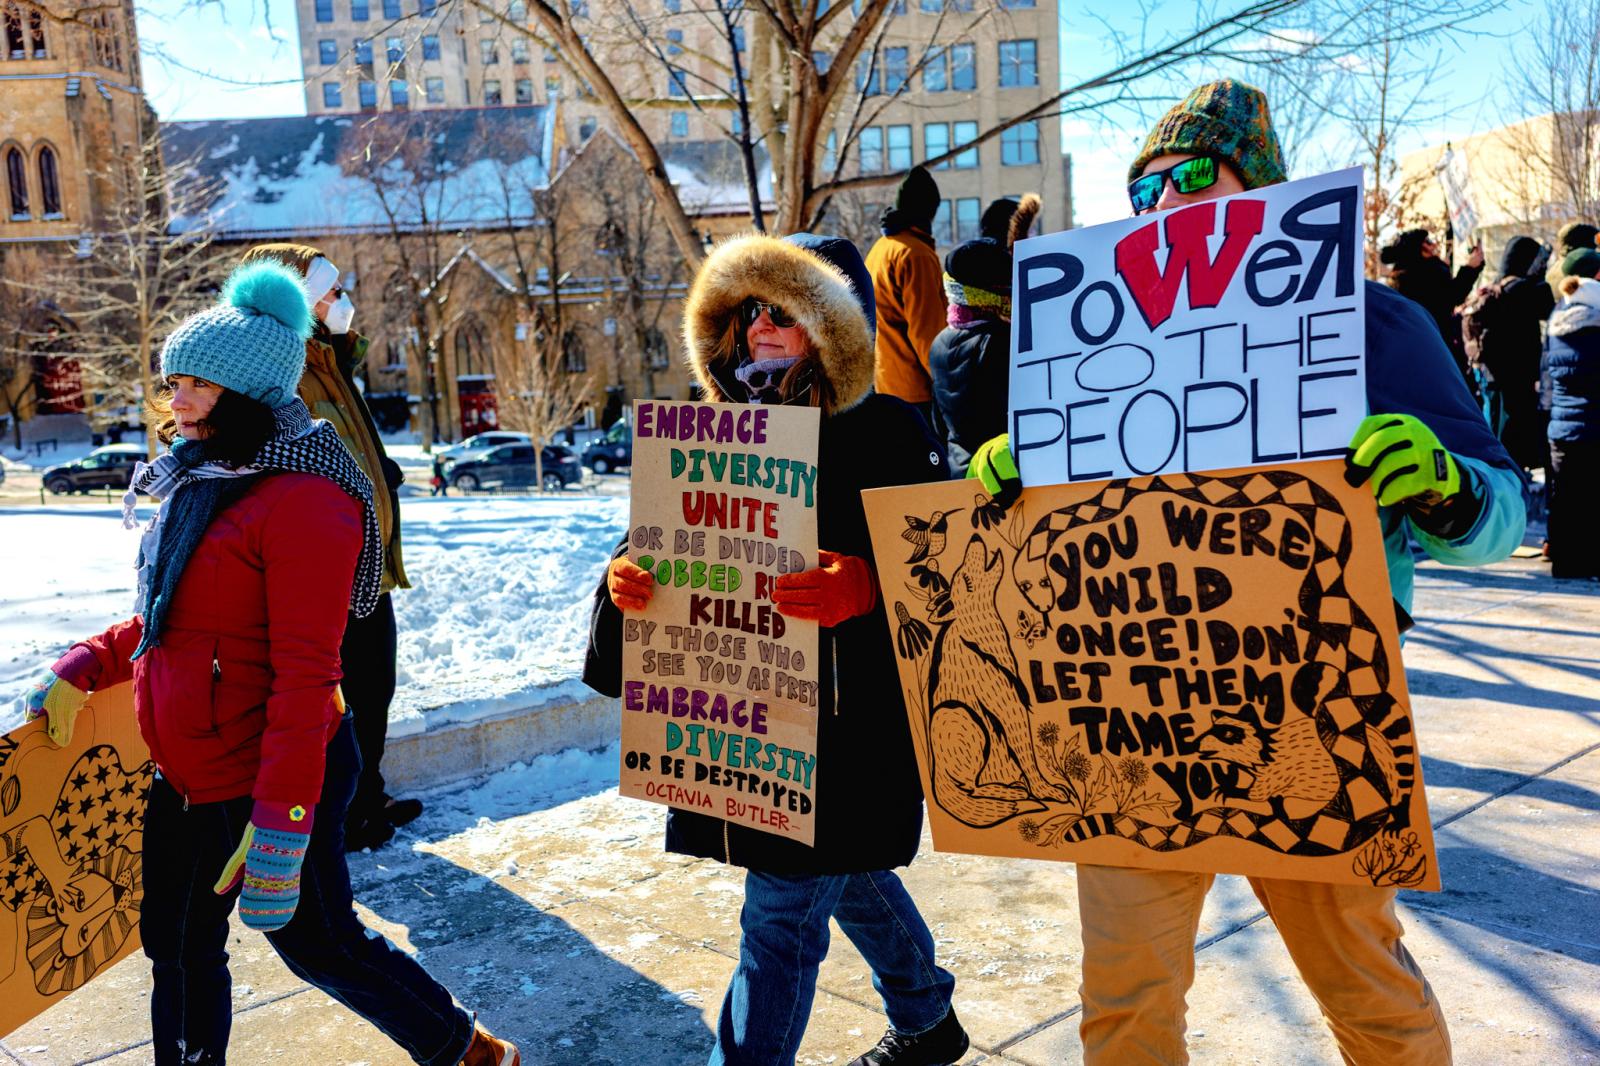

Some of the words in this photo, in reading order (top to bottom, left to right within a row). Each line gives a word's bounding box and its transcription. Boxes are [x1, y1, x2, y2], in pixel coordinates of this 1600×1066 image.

[1017, 343, 1155, 400] TO
[1164, 307, 1361, 379] THE
[637, 403, 768, 444] EMBRACE
[1013, 369, 1357, 482] PEOPLE
[671, 448, 817, 508] DIVERSITY
[682, 490, 779, 539] UNITE
[632, 526, 664, 550] OR
[674, 529, 706, 557] BE
[719, 535, 806, 573] DIVIDED
[1049, 514, 1139, 612] YOU
[1161, 500, 1311, 571] WERE
[690, 594, 786, 639] KILLED
[1085, 562, 1233, 618] WILD
[625, 618, 657, 646] BY
[665, 626, 746, 660] THOSE
[758, 640, 806, 672] WHO
[642, 649, 685, 676] SEE
[696, 655, 742, 685] YOU
[747, 666, 770, 691] AS
[775, 671, 818, 707] PREY
[1029, 660, 1111, 704] LET
[1130, 664, 1285, 725] THEM
[625, 680, 768, 735] EMBRACE
[1068, 706, 1199, 757] TAME
[625, 751, 651, 771] OR
[660, 755, 685, 779] BE
[695, 762, 812, 815] DESTROYED
[666, 721, 816, 790] DIVERSITY
[1152, 761, 1239, 821] YOU
